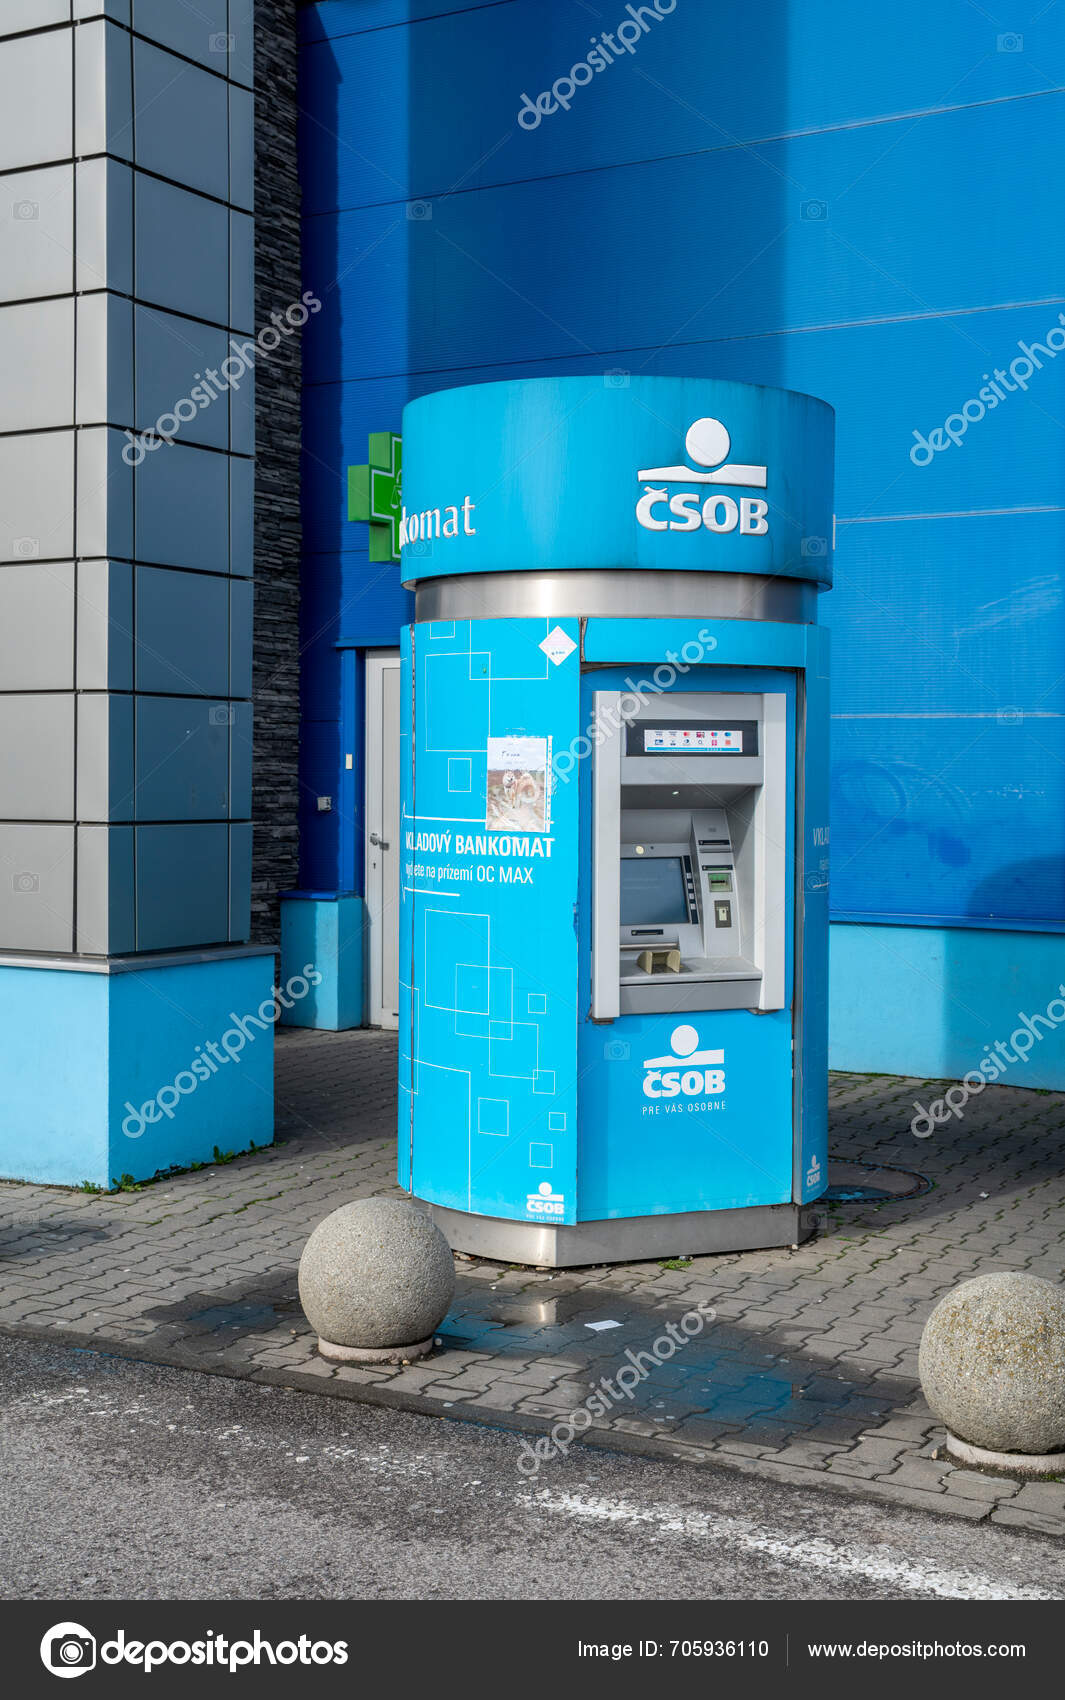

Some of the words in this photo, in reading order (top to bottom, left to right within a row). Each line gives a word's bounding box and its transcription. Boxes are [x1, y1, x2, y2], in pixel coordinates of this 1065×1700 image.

[399, 496, 476, 550] komat
[636, 486, 769, 536] ČSOB
[455, 834, 555, 858] BANKOMAT
[425, 865, 436, 879] na
[437, 863, 474, 883] prízemí
[476, 865, 495, 883] OC
[499, 866, 534, 885] MAX
[642, 1069, 726, 1099] ČSOB
[642, 1105, 660, 1116] PRE
[687, 1100, 726, 1113] OSOBNE
